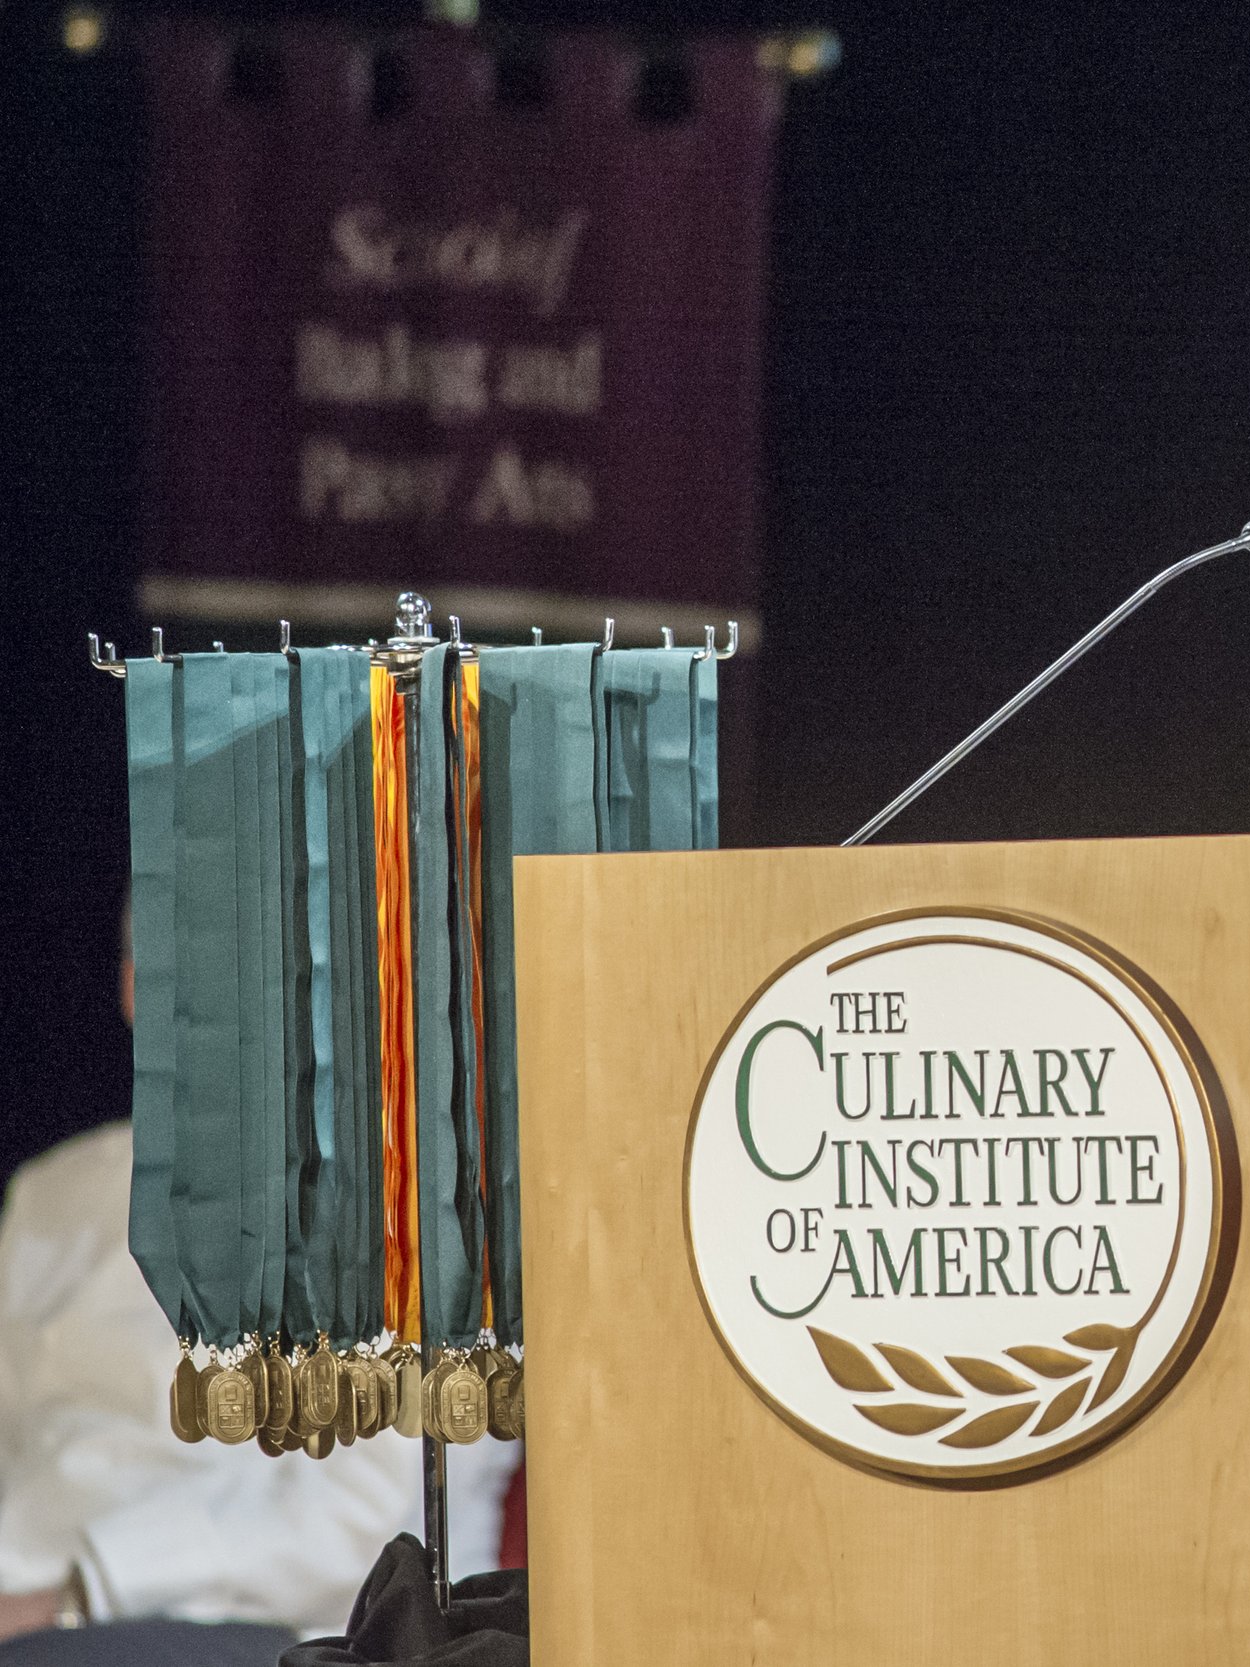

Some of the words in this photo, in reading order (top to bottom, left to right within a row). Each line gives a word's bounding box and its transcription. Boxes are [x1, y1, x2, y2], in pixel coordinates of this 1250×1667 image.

[830, 991, 907, 1034] THE
[734, 1018, 1115, 1182] CULINARY
[830, 1135, 1164, 1210] INSTITUTE
[765, 1207, 824, 1254] OF
[750, 1225, 1131, 1320] AMERICA
